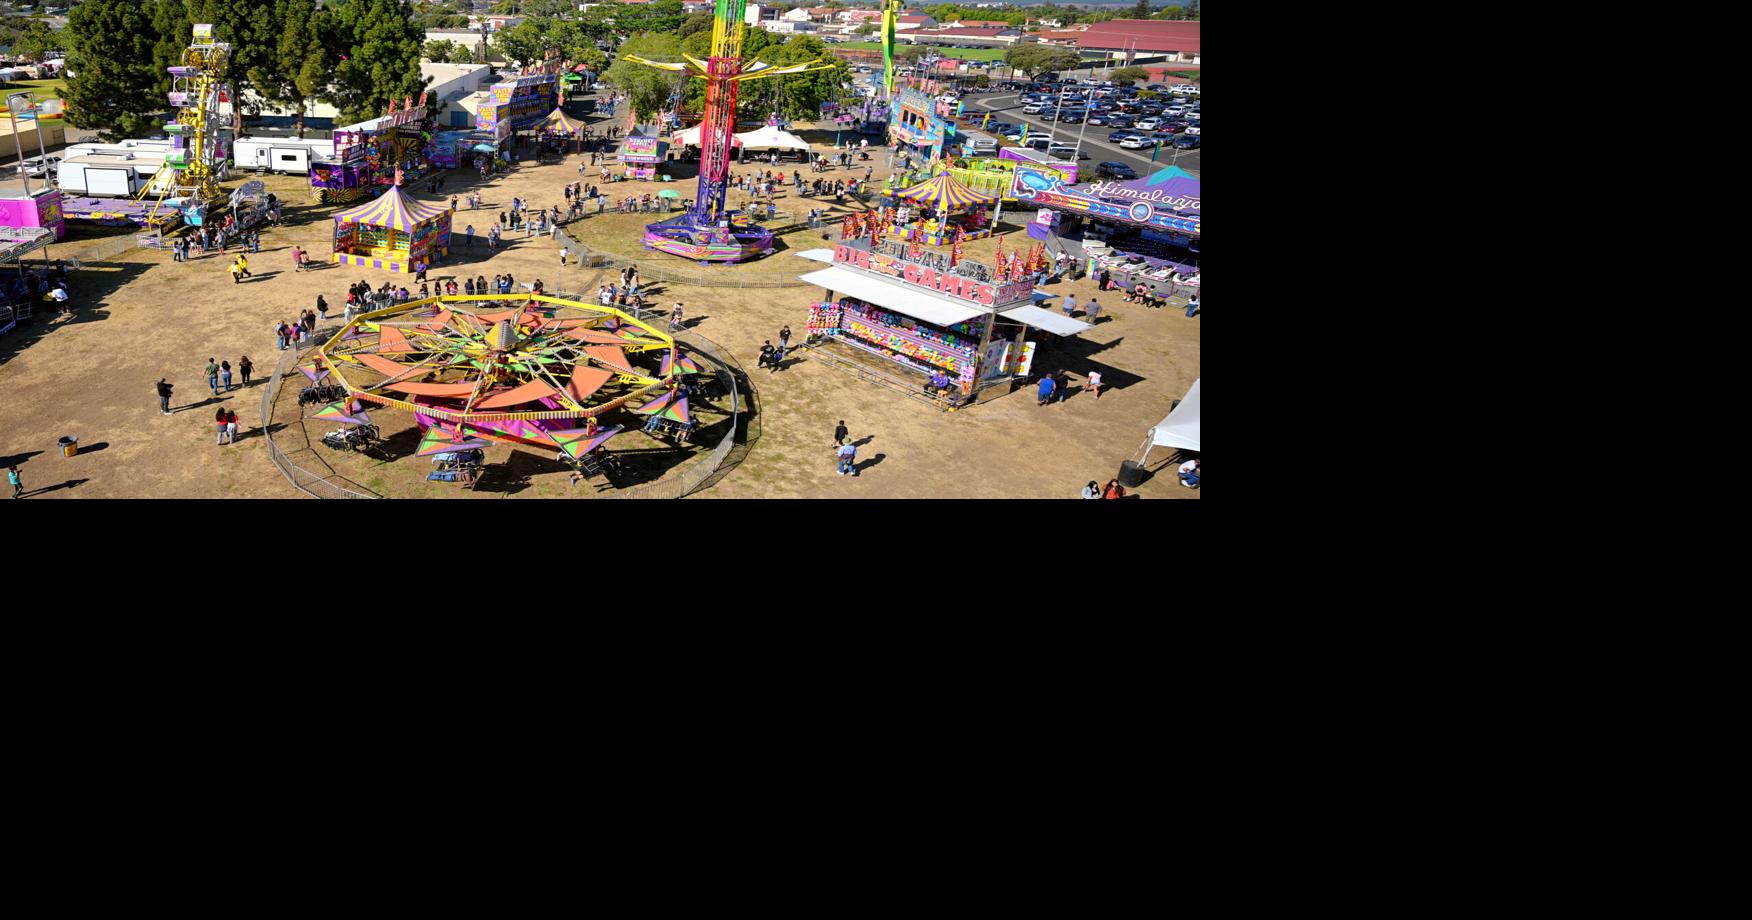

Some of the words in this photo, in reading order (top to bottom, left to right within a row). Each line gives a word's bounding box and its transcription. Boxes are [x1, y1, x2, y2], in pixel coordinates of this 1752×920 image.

[1083, 180, 1200, 211] Himalaya
[833, 244, 870, 270] BIG
[903, 263, 993, 305] GAMES
